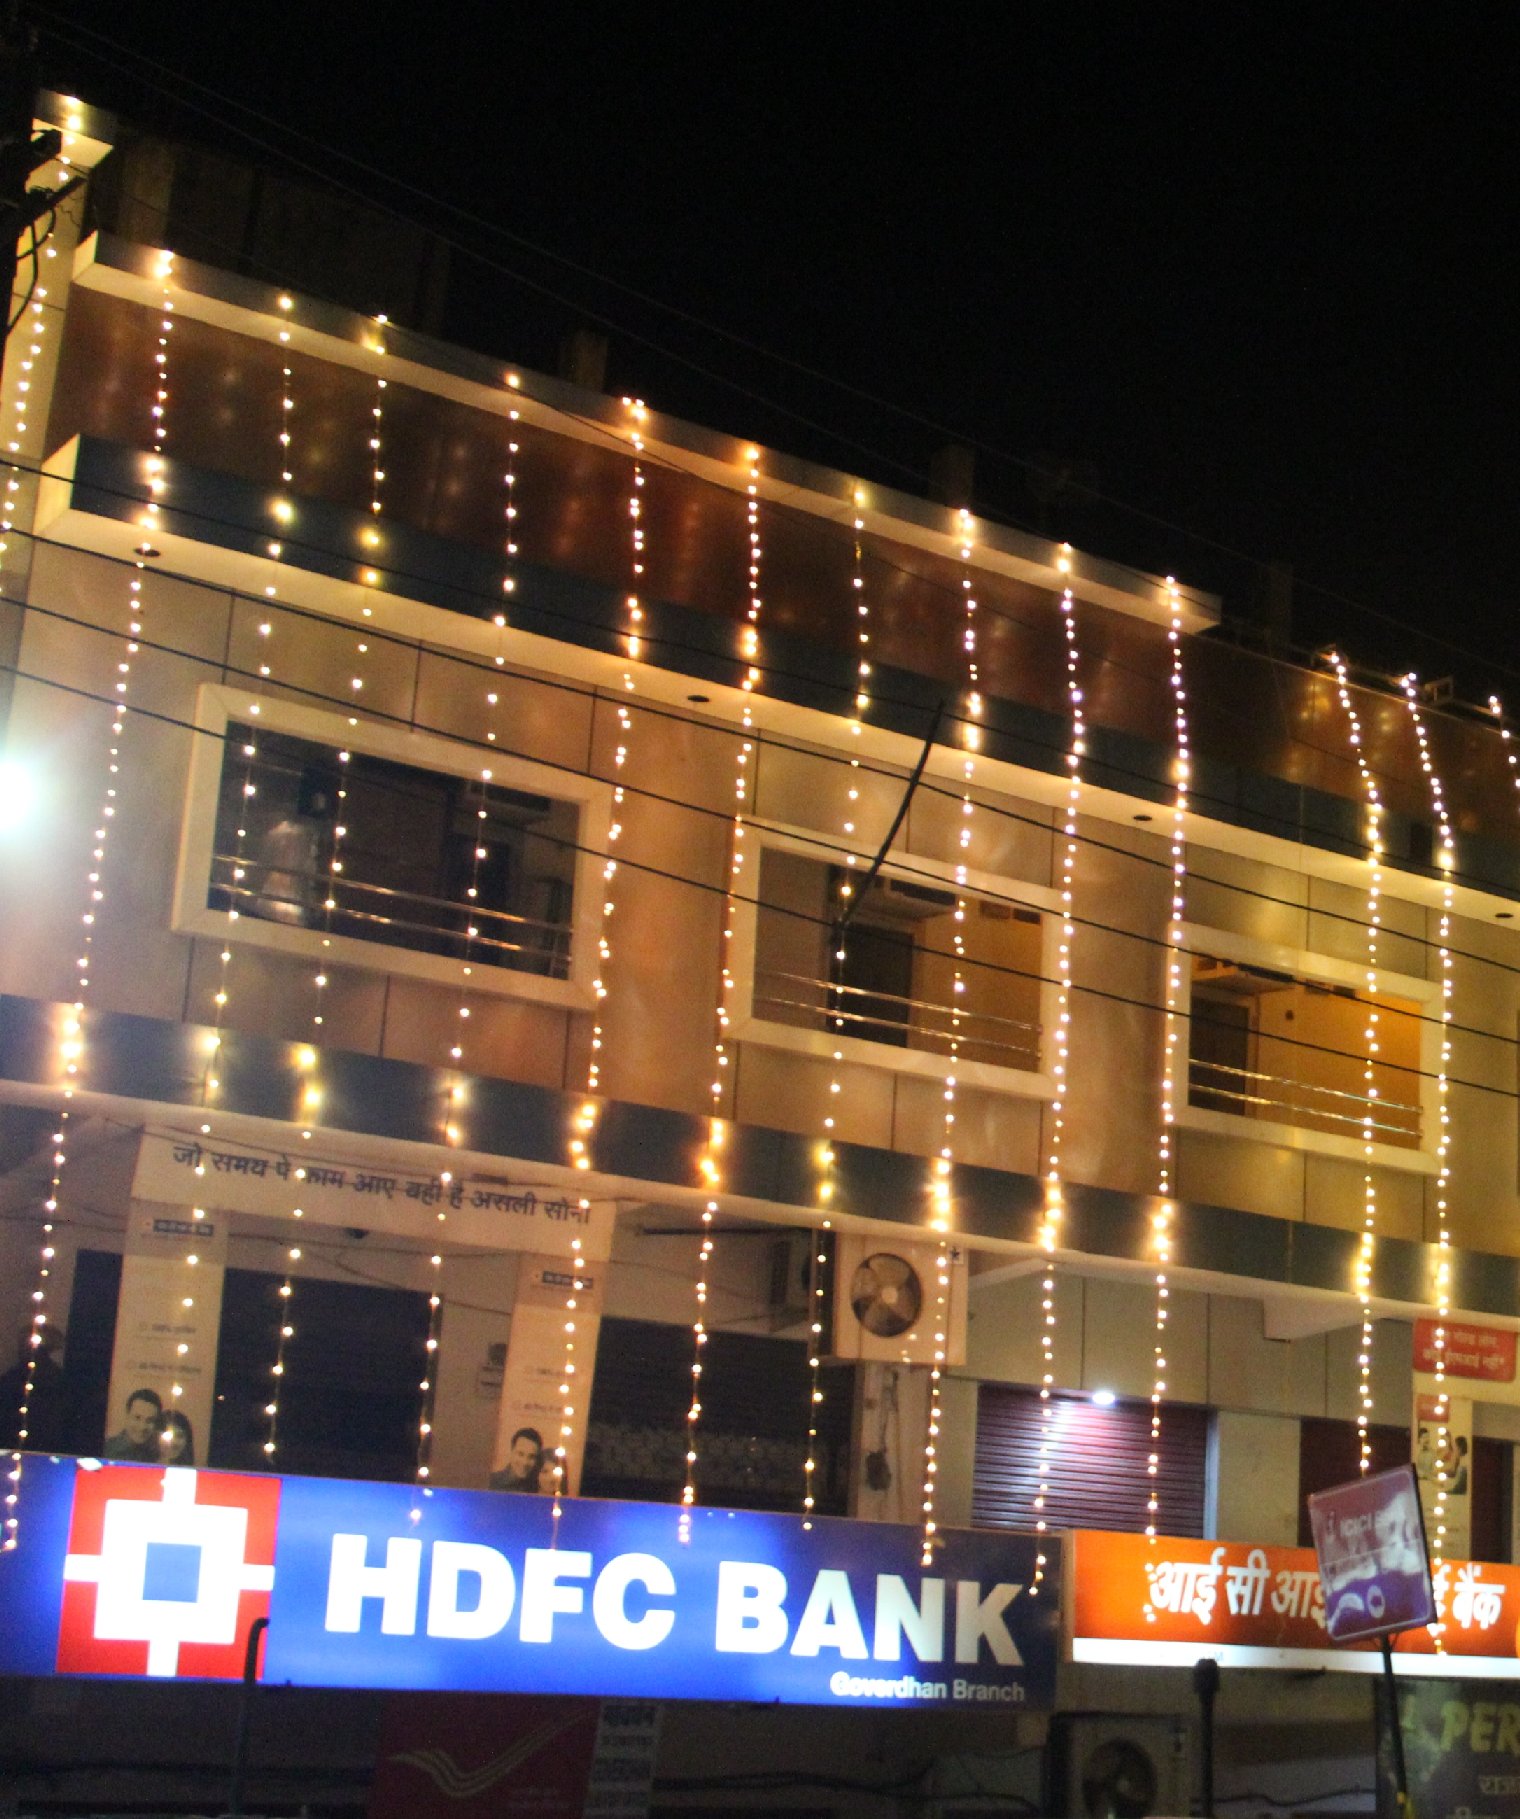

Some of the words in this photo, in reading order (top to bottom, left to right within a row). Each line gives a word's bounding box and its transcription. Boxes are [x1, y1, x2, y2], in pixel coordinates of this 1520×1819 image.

[173, 1142, 203, 1168] जो
[211, 1152, 269, 1178] समय
[471, 1189, 538, 1217] असली
[325, 1533, 677, 1650] HDFC
[714, 1560, 1026, 1666] BANK
[1150, 1546, 1223, 1626] आई
[1225, 1549, 1271, 1616] सी
[1452, 1562, 1507, 1630] बैंक
[952, 1679, 1025, 1701] Branch
